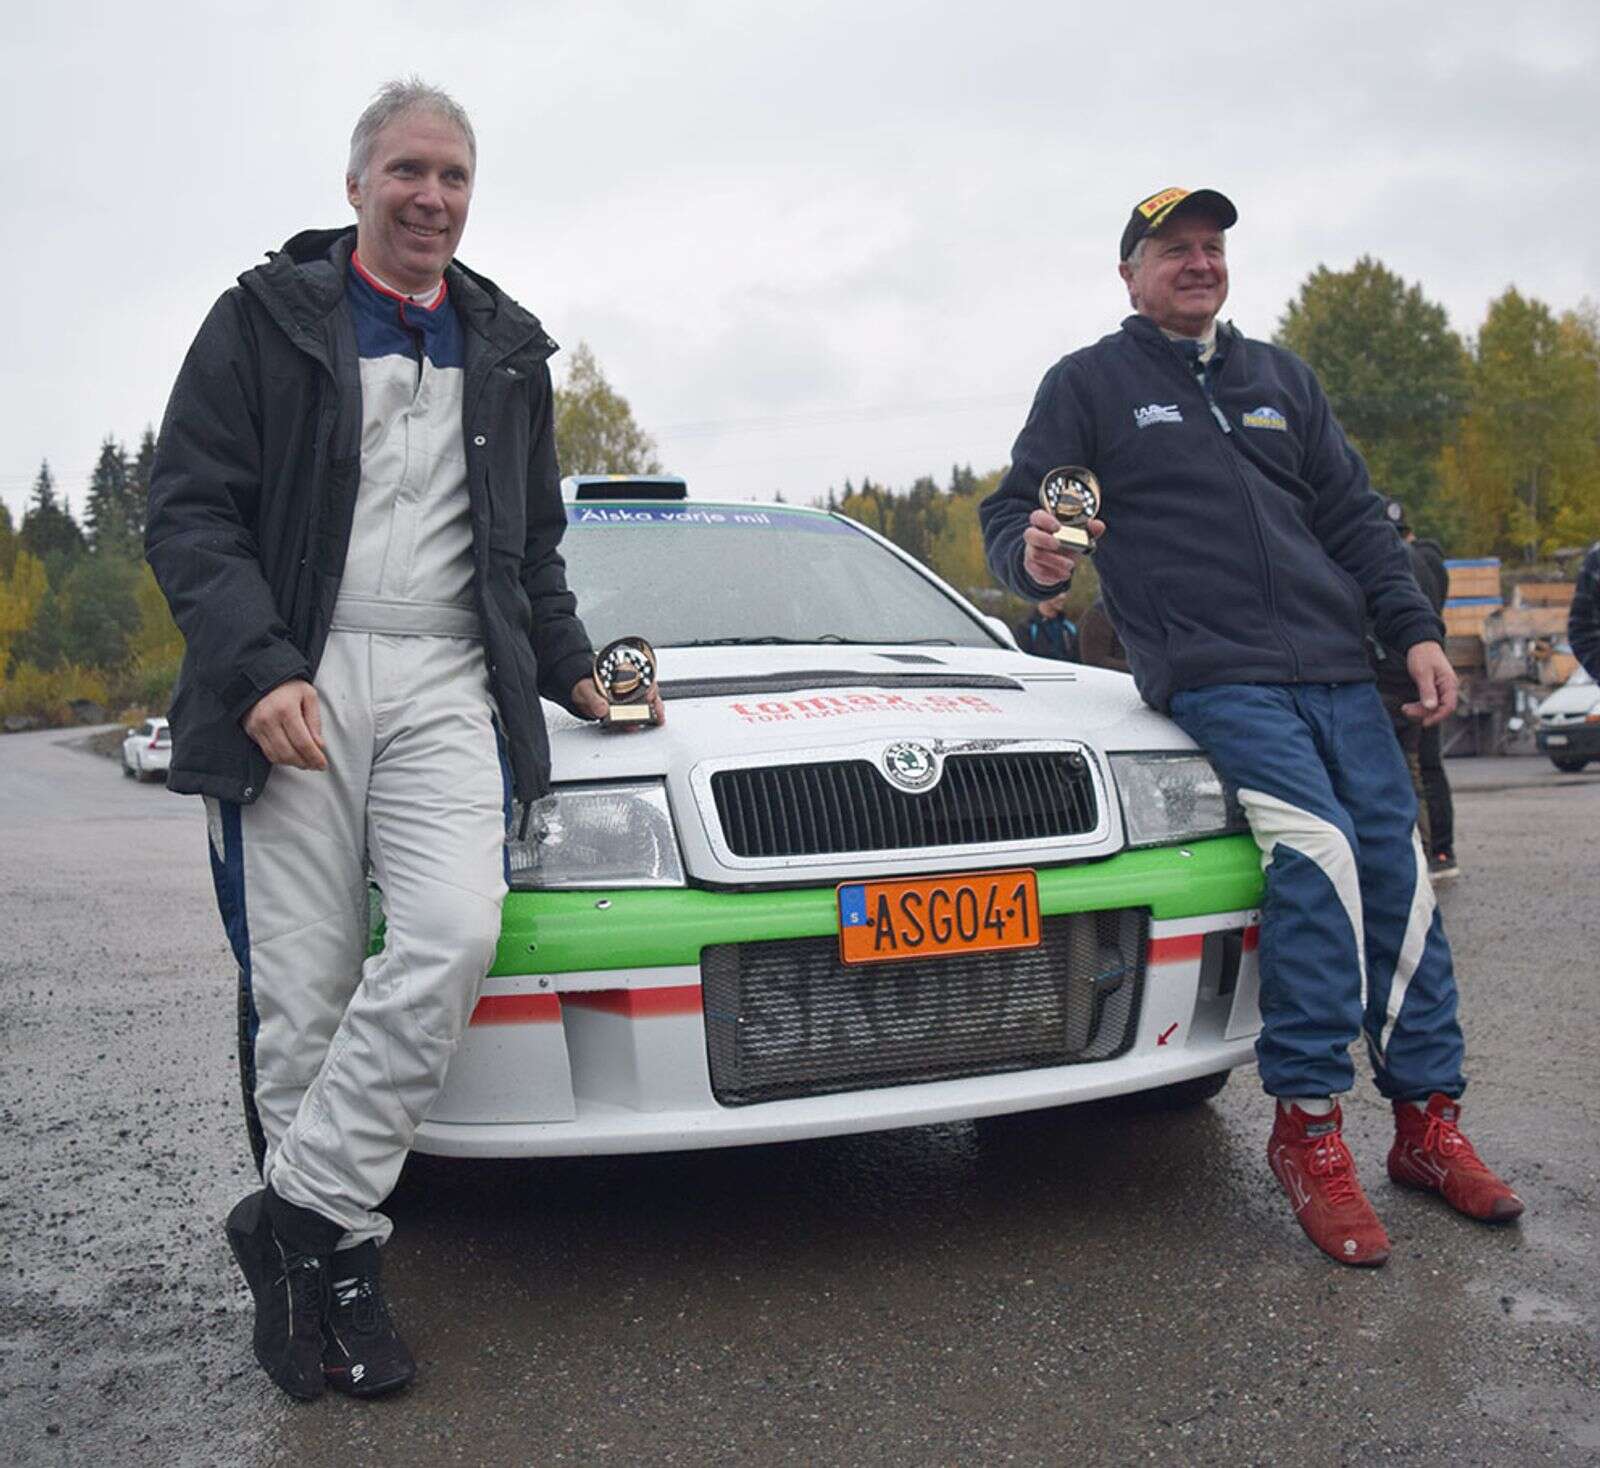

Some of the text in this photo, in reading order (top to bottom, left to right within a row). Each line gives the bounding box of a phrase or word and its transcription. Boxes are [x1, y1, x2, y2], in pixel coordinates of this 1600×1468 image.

[580, 508, 771, 525] Älska varje mil
[850, 911, 861, 924] S
